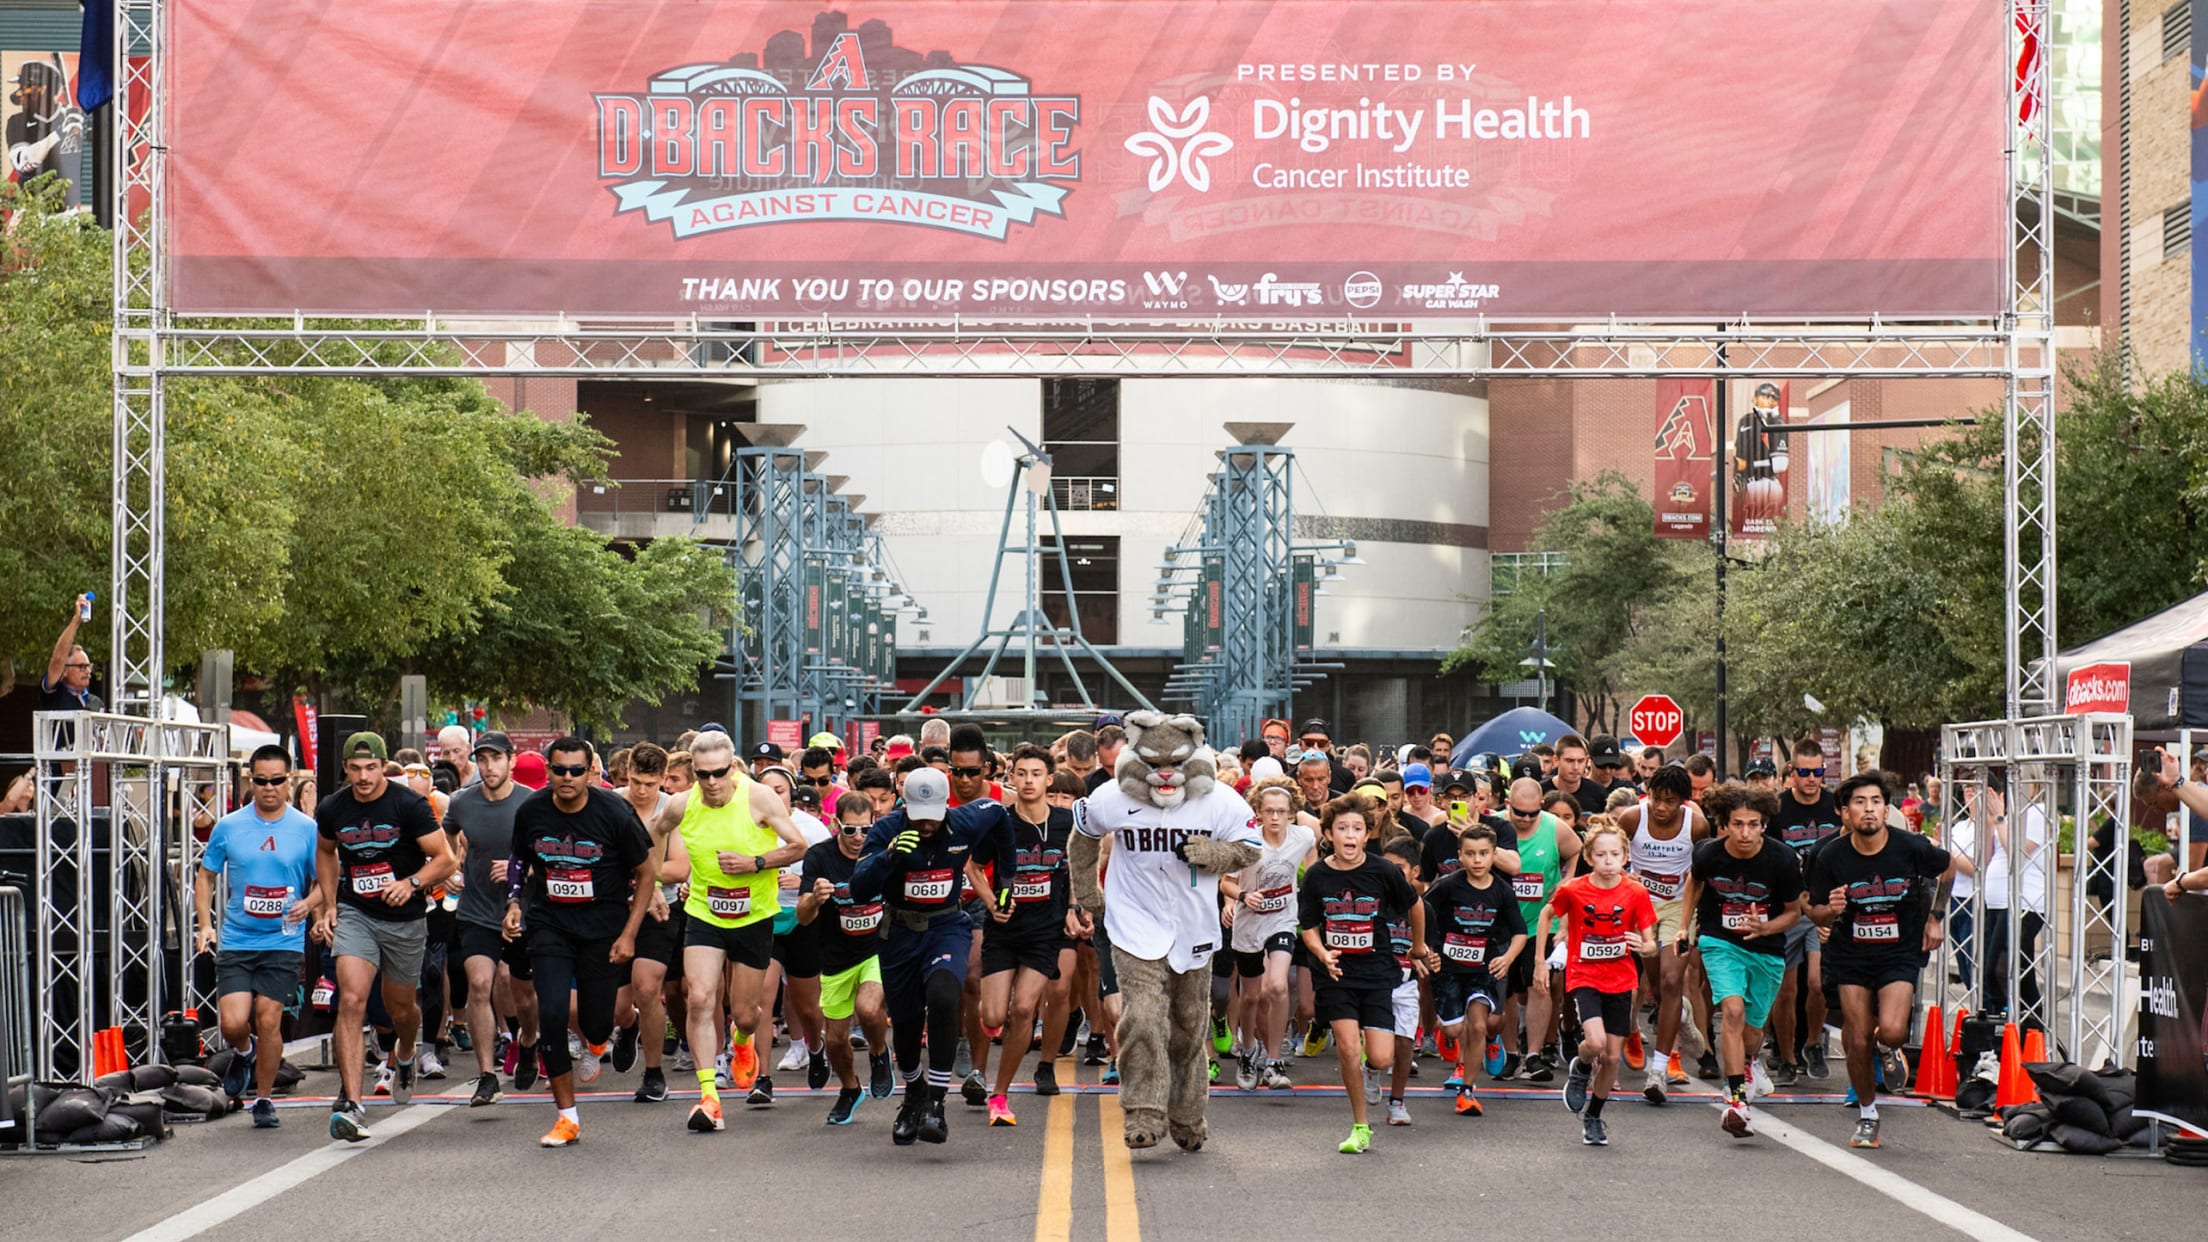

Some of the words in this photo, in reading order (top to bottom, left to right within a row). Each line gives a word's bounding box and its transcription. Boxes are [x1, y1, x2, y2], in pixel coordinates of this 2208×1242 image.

[1238, 64, 1422, 81] PRESENTED
[1437, 64, 1477, 81] BY
[1254, 97, 1423, 152] Dignity
[1436, 96, 1590, 139] Health
[892, 96, 1081, 177] RACE
[1253, 163, 1348, 188] Cancer
[1356, 162, 1470, 188] Institute
[689, 193, 837, 229] AGAINST
[853, 195, 994, 230] CANCER
[681, 277, 780, 300] THANK
[792, 278, 849, 301] YOU
[859, 278, 895, 301] TO
[903, 278, 964, 301] OUR
[971, 278, 1126, 301] SPONSORS
[1252, 273, 1324, 307] fry's
[1347, 285, 1380, 294] PEPSI
[1402, 284, 1456, 299] SUPER
[1458, 284, 1499, 299] STAR
[1143, 301, 1188, 309] WAYMO
[1425, 300, 1447, 309] CAR
[1448, 300, 1479, 309] WASH
[2069, 675, 2127, 706] dbacks.com
[1633, 711, 1680, 732] STOP
[553, 883, 585, 895] 0921
[911, 883, 946, 896] 0681
[1012, 885, 1045, 896] 0954
[1643, 879, 1673, 895] 0396
[249, 899, 282, 912] 0288
[712, 900, 745, 912] 0097
[1260, 897, 1288, 911] 0591
[846, 916, 877, 929] 0981
[1857, 926, 1892, 938] 0154
[1332, 935, 1367, 947] 0816
[1449, 946, 1480, 961] 0828
[1586, 945, 1622, 957] 0592
